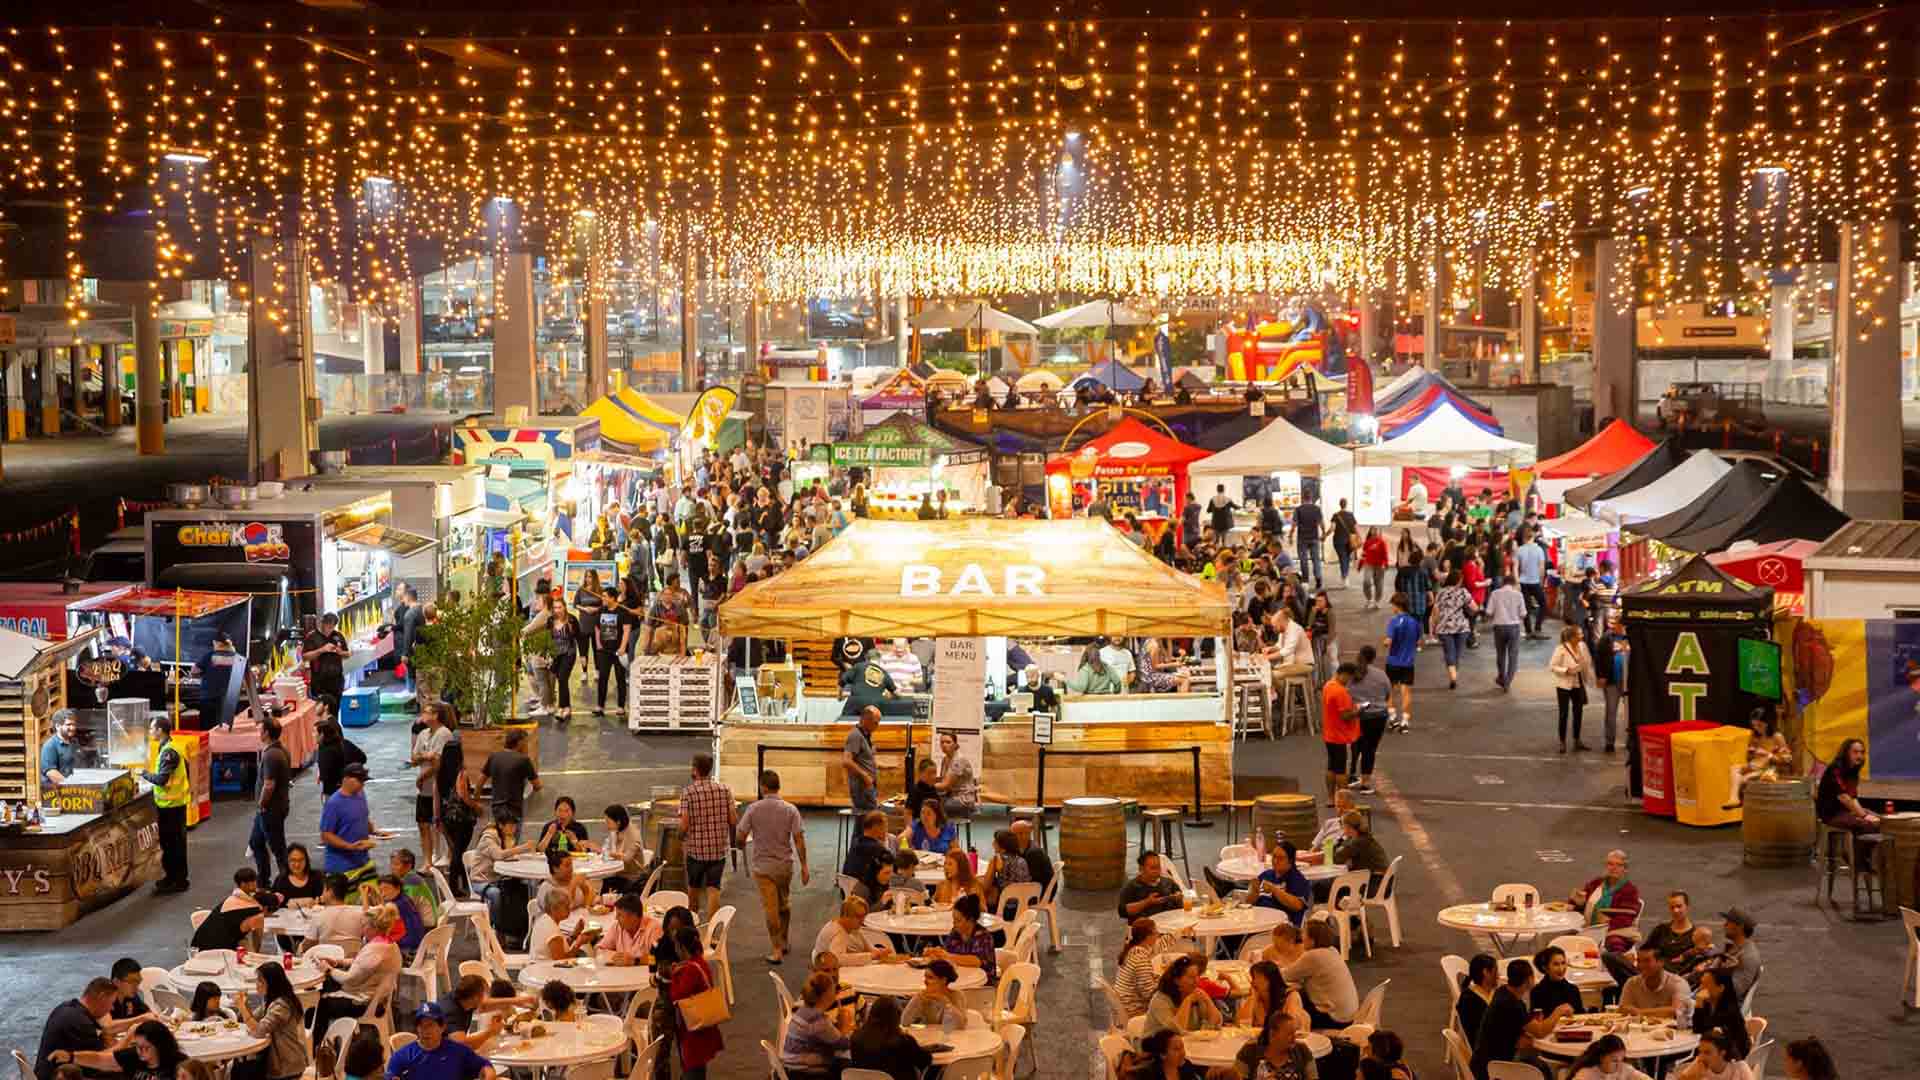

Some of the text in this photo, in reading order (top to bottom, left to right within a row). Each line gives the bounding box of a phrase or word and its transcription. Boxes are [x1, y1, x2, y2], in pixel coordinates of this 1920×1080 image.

[834, 447, 922, 461] ICE TEA FACTORY
[899, 563, 1048, 598] BAR
[1660, 580, 1723, 594] ATM
[950, 640, 974, 649] BAR
[945, 650, 977, 661] MENU
[1665, 632, 1711, 721] AT
[51, 797, 94, 810] CORN
[0, 863, 50, 893] Y'S
